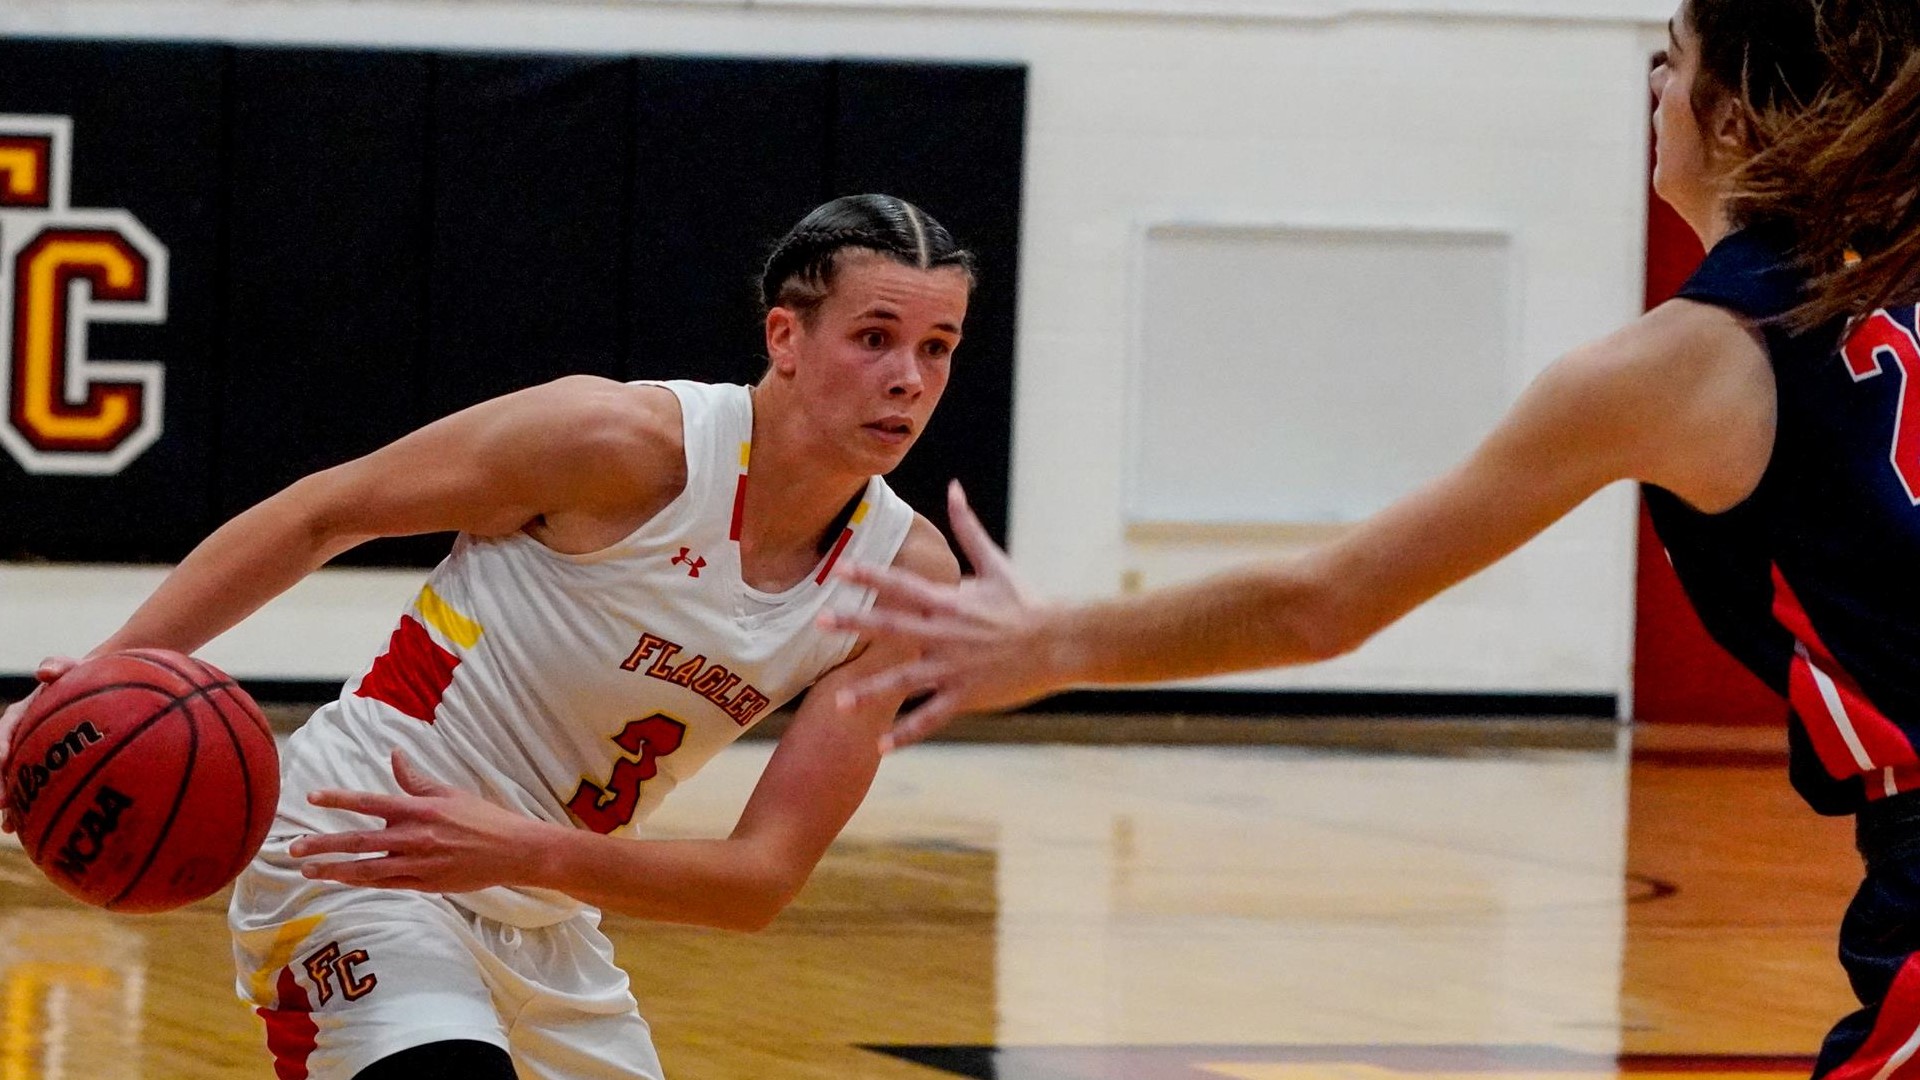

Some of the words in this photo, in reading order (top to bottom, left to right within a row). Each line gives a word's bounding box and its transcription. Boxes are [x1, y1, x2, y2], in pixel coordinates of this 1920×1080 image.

[1840, 302, 1920, 506] 2
[619, 632, 771, 727] FLAGLER
[565, 710, 688, 836] 3
[53, 784, 134, 878] NCAA
[302, 940, 378, 1007] FC
